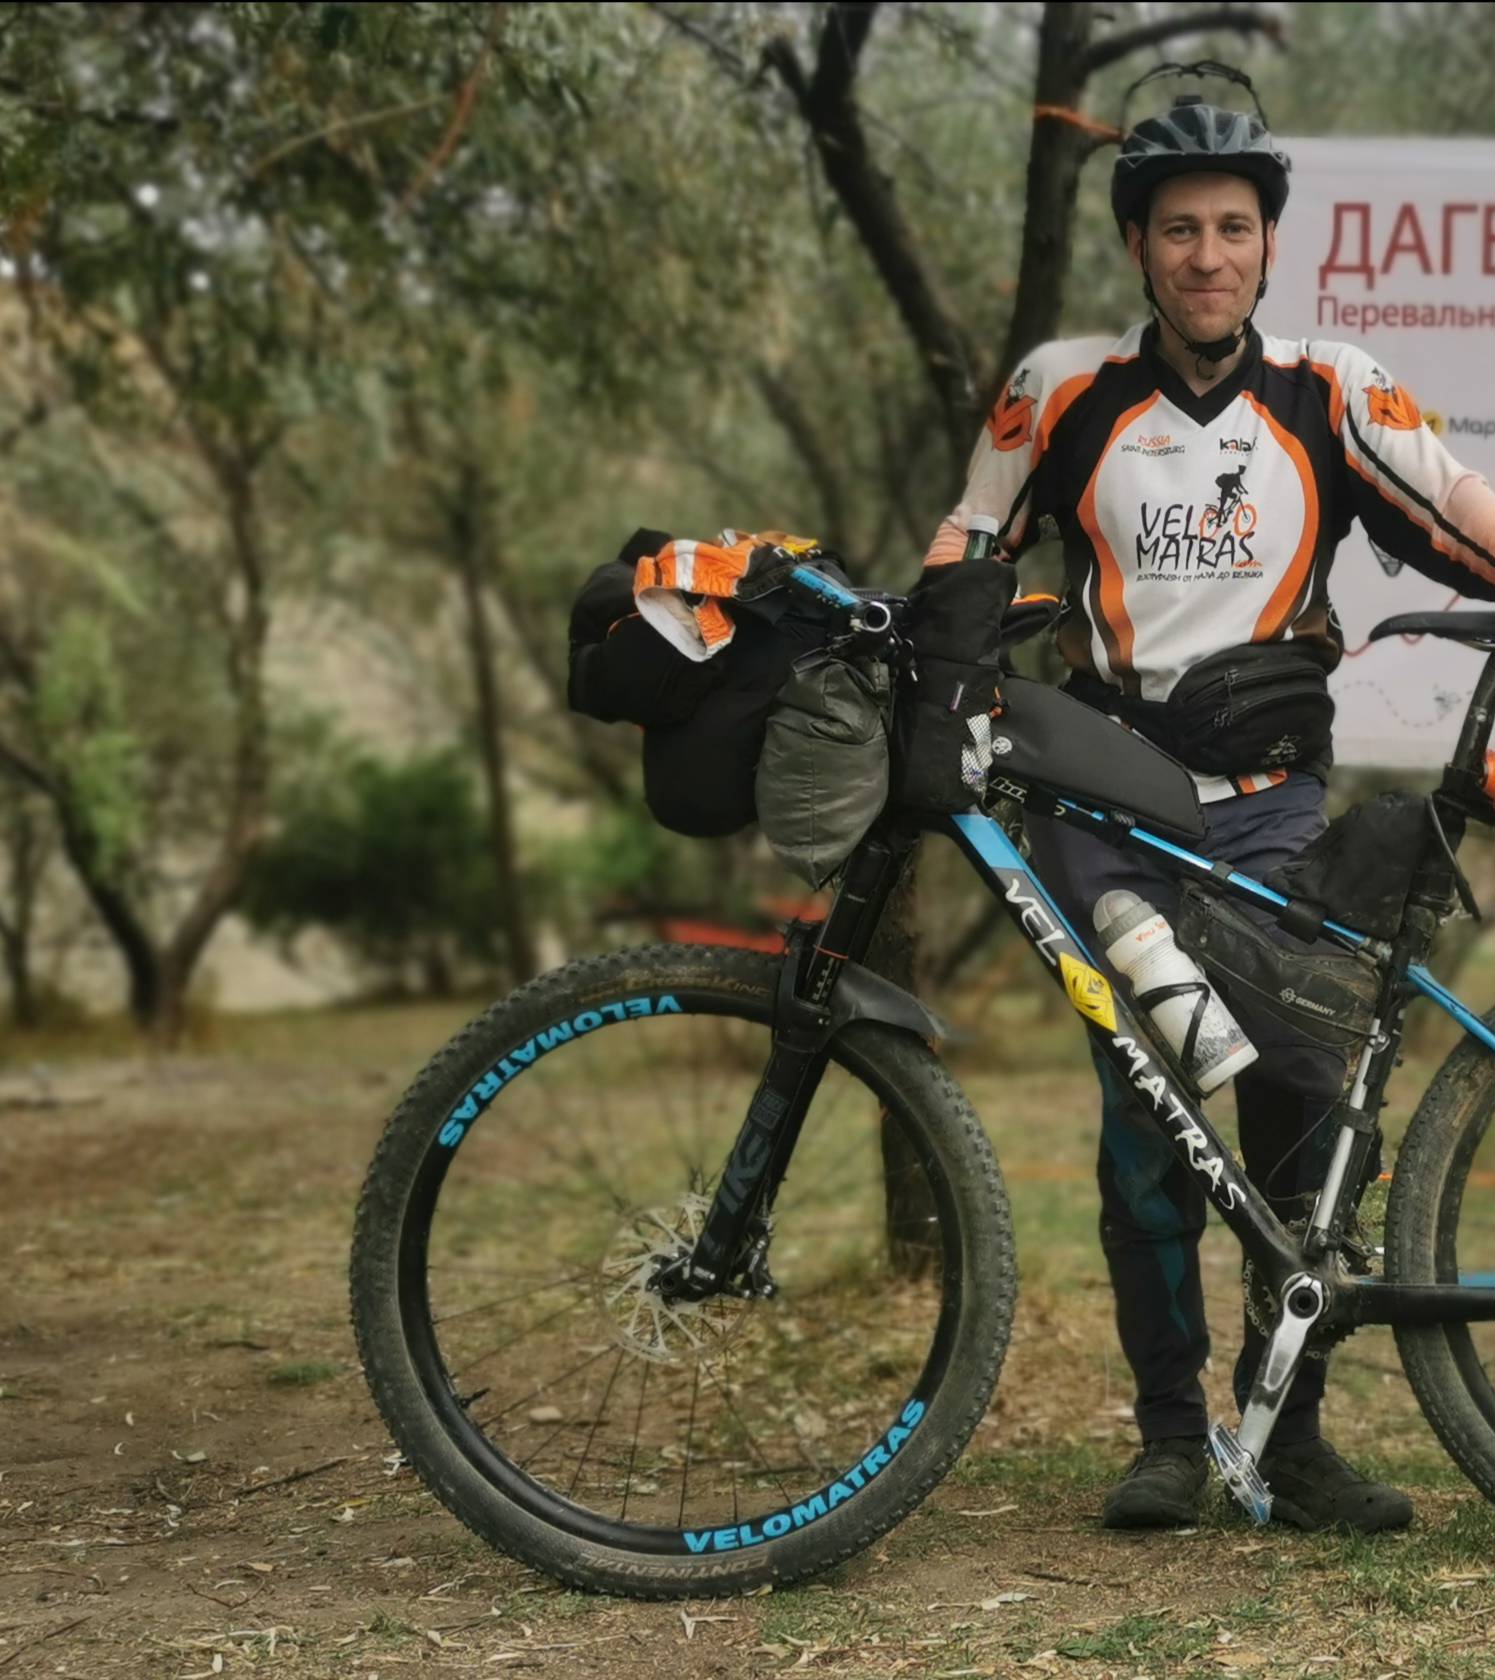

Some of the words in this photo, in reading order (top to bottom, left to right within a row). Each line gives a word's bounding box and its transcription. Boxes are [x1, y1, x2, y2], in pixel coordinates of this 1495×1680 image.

[1136, 531, 1255, 571] MATRAS
[1005, 877, 1066, 966] VEL
[1295, 996, 1336, 1016] GERMANY
[437, 994, 683, 1149] VELOMATRAS
[1112, 1035, 1247, 1210] MATRAS
[683, 1399, 926, 1554] VELOMATRAS
